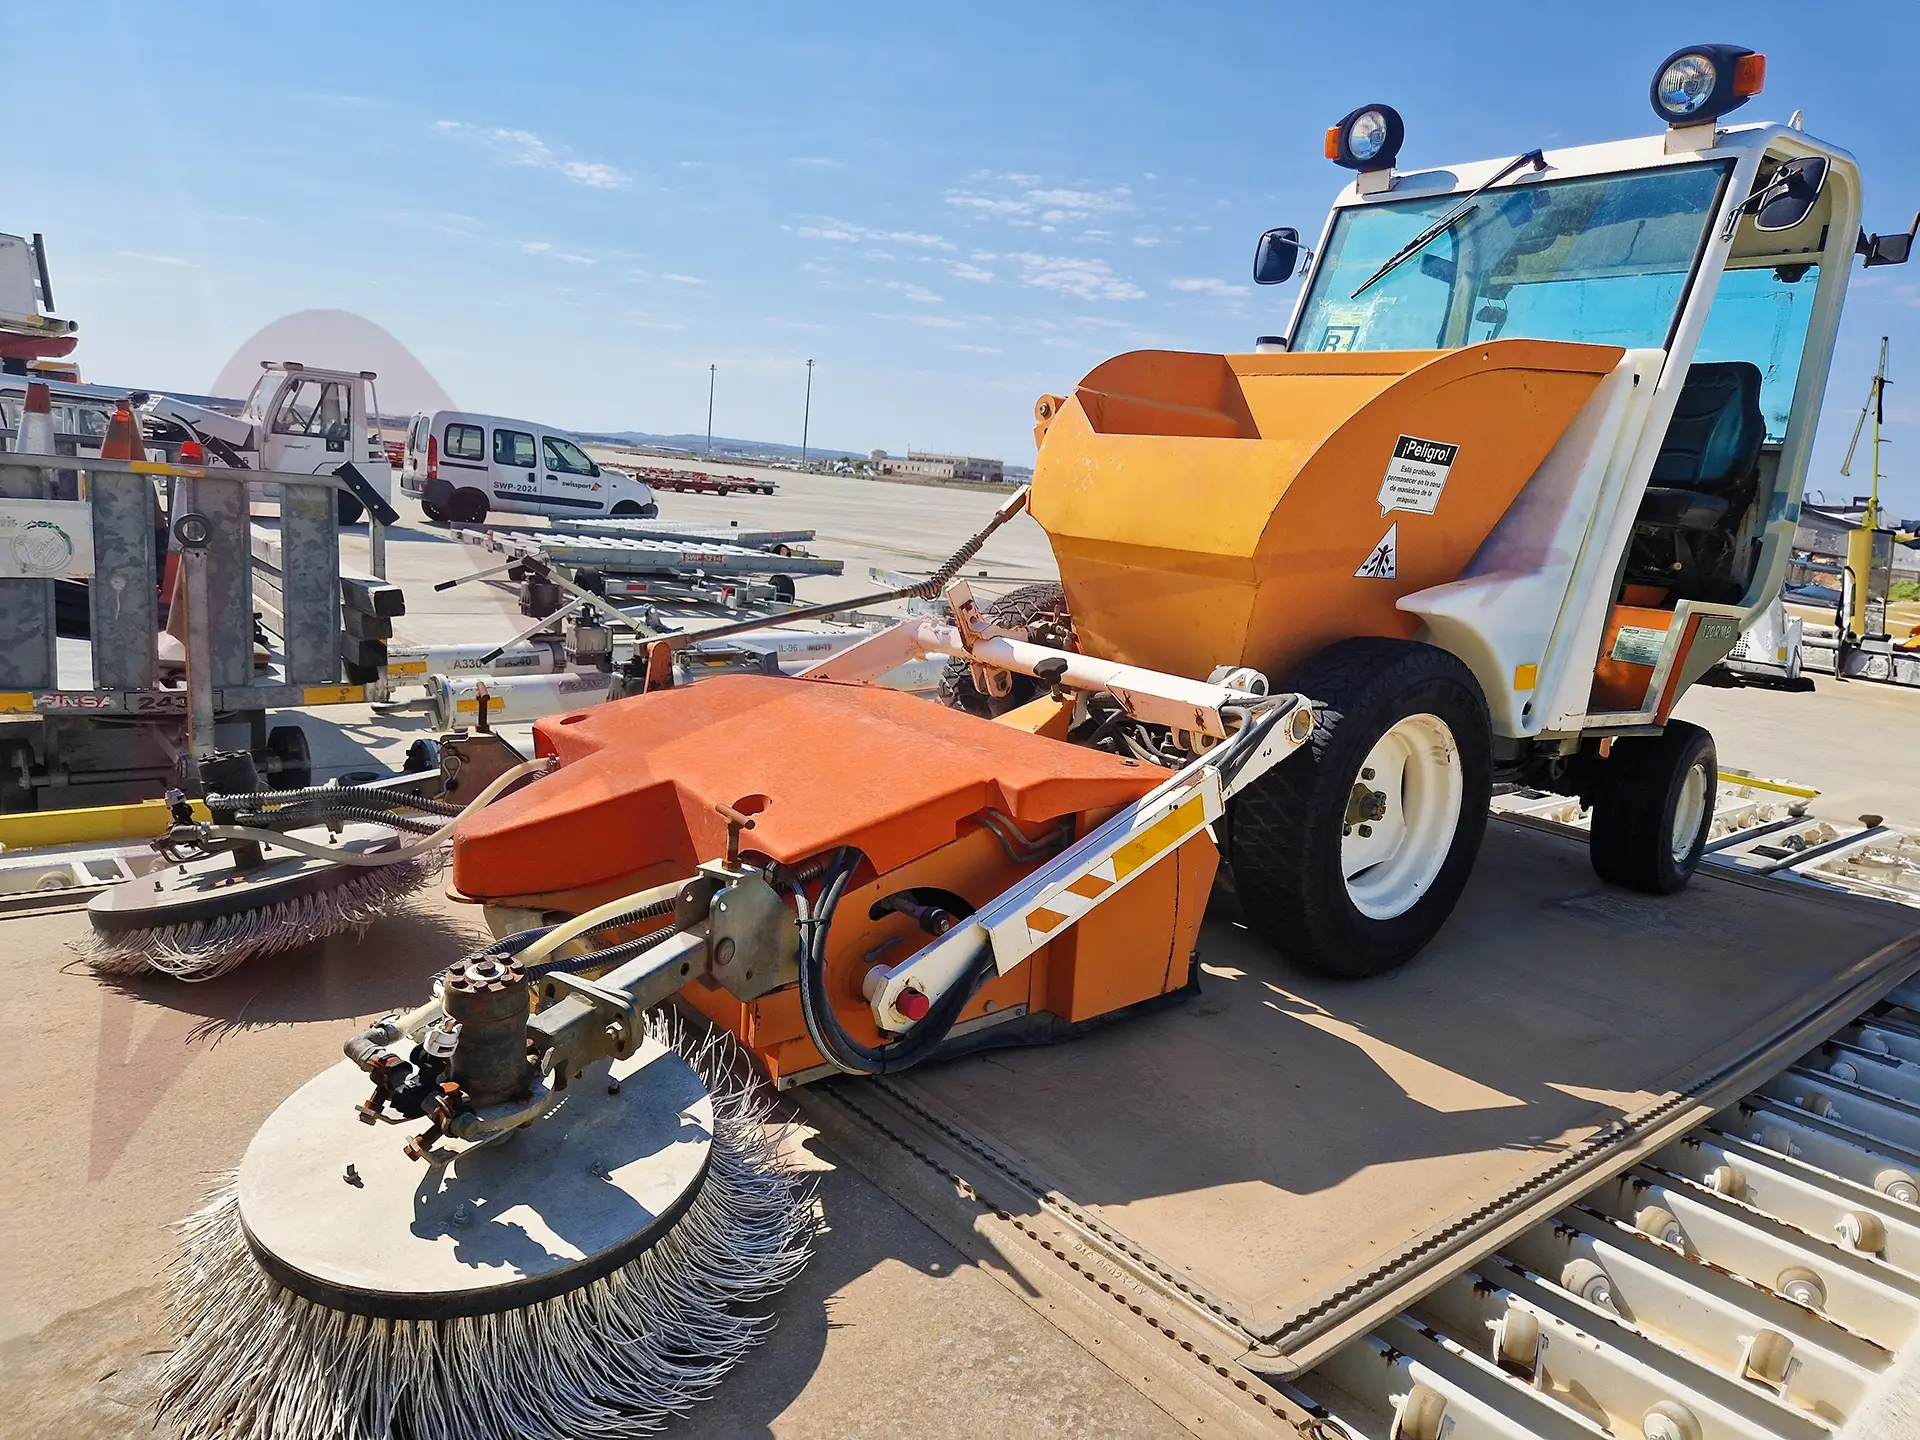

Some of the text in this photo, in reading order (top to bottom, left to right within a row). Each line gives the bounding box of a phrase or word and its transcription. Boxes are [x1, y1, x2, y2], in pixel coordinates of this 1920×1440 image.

[1401, 440, 1451, 462] ¡Peligro!
[1412, 468, 1437, 477] prohibido
[493, 481, 538, 493] SWP-2024
[562, 480, 592, 490] swissport
[1387, 475, 1417, 485] permanecer
[1430, 481, 1441, 489] zona
[1397, 487, 1421, 496] maniobra
[1421, 489, 1428, 497] de
[778, 643, 798, 653] IL-96
[453, 658, 482, 669] A330
